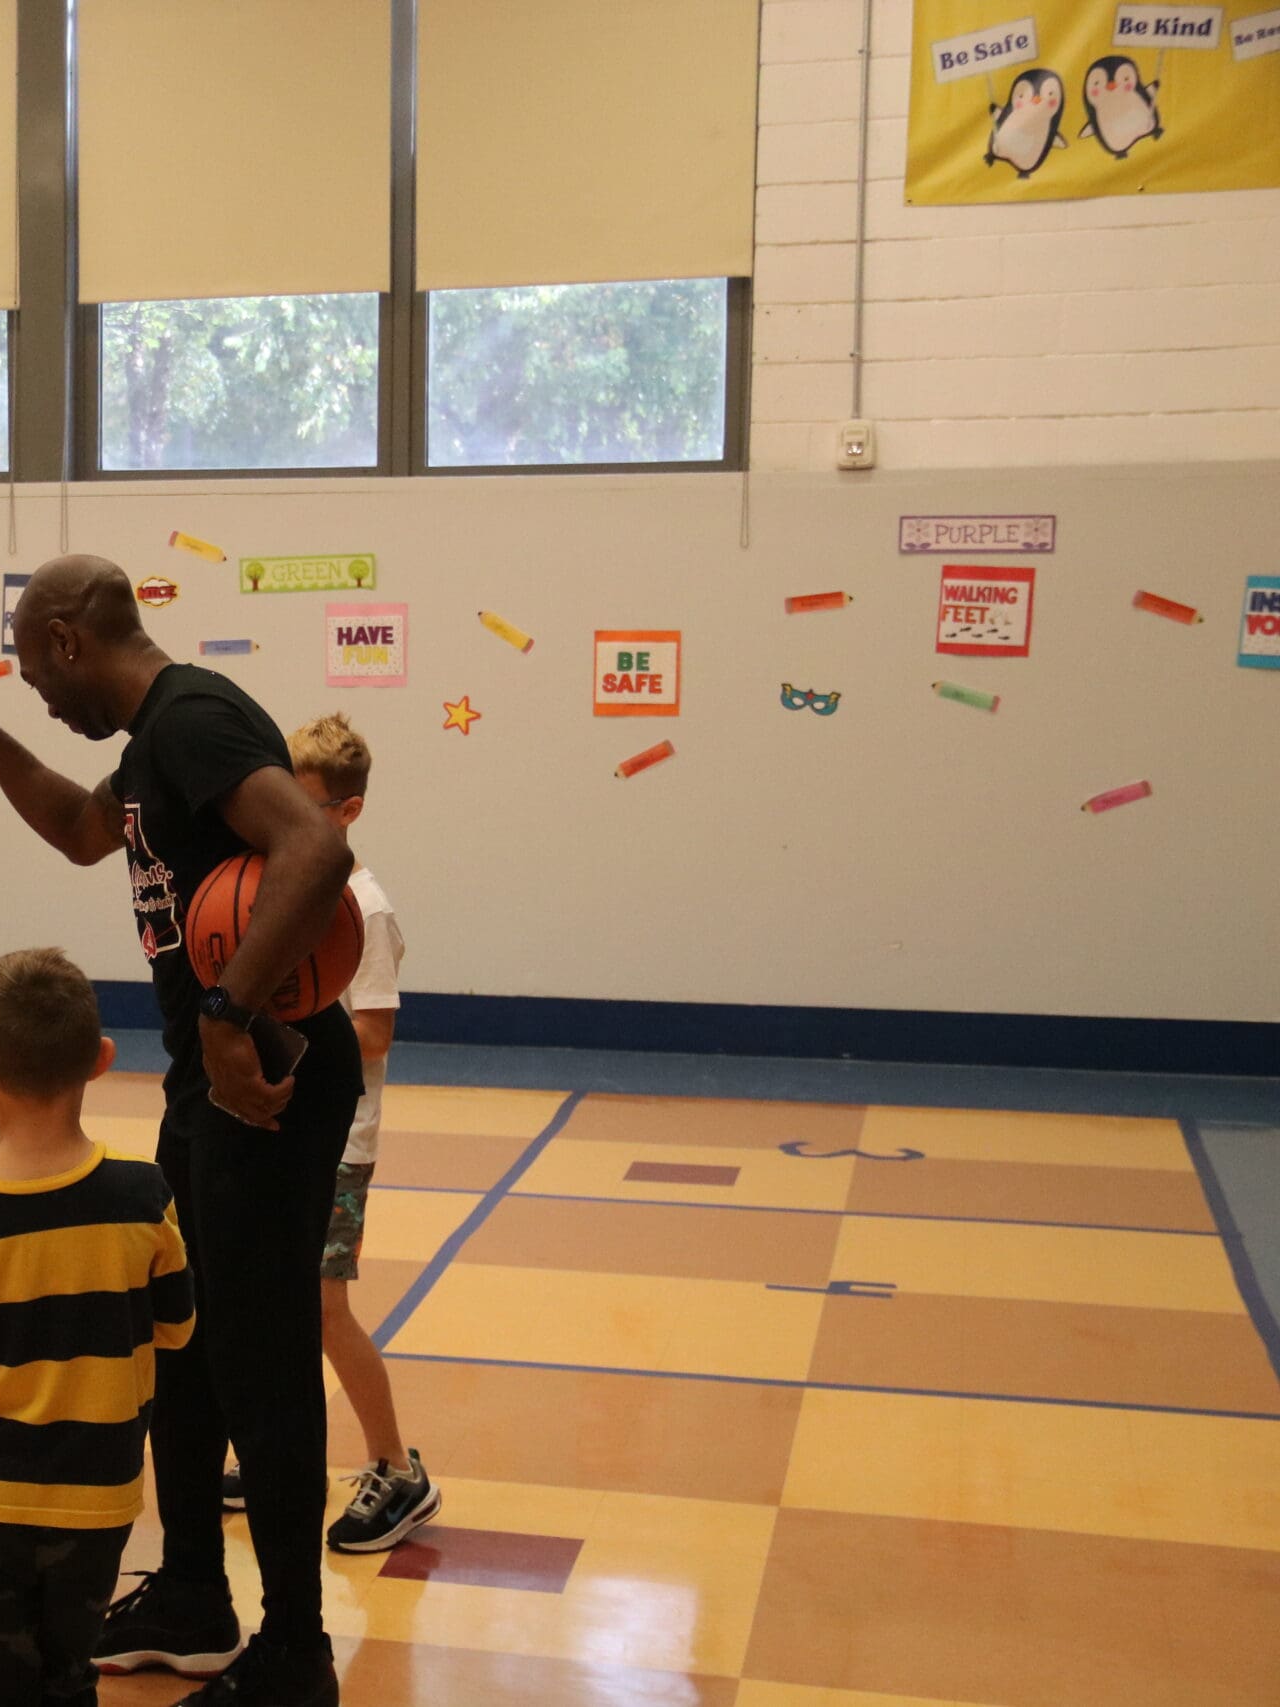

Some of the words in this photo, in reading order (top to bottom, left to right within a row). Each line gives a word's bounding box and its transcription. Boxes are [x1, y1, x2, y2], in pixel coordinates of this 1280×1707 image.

[1119, 17, 1148, 35] Be
[1153, 16, 1213, 36] Kind
[940, 51, 969, 70] Be
[974, 34, 1029, 62] Safe
[935, 524, 1019, 545] PURPLE
[272, 560, 342, 582] GREEN
[944, 585, 1018, 604] WALKING
[941, 604, 990, 624] FEET
[337, 626, 394, 646] HAVE
[343, 646, 388, 665] FUN
[617, 651, 650, 672] BE
[602, 673, 662, 694] SAFE
